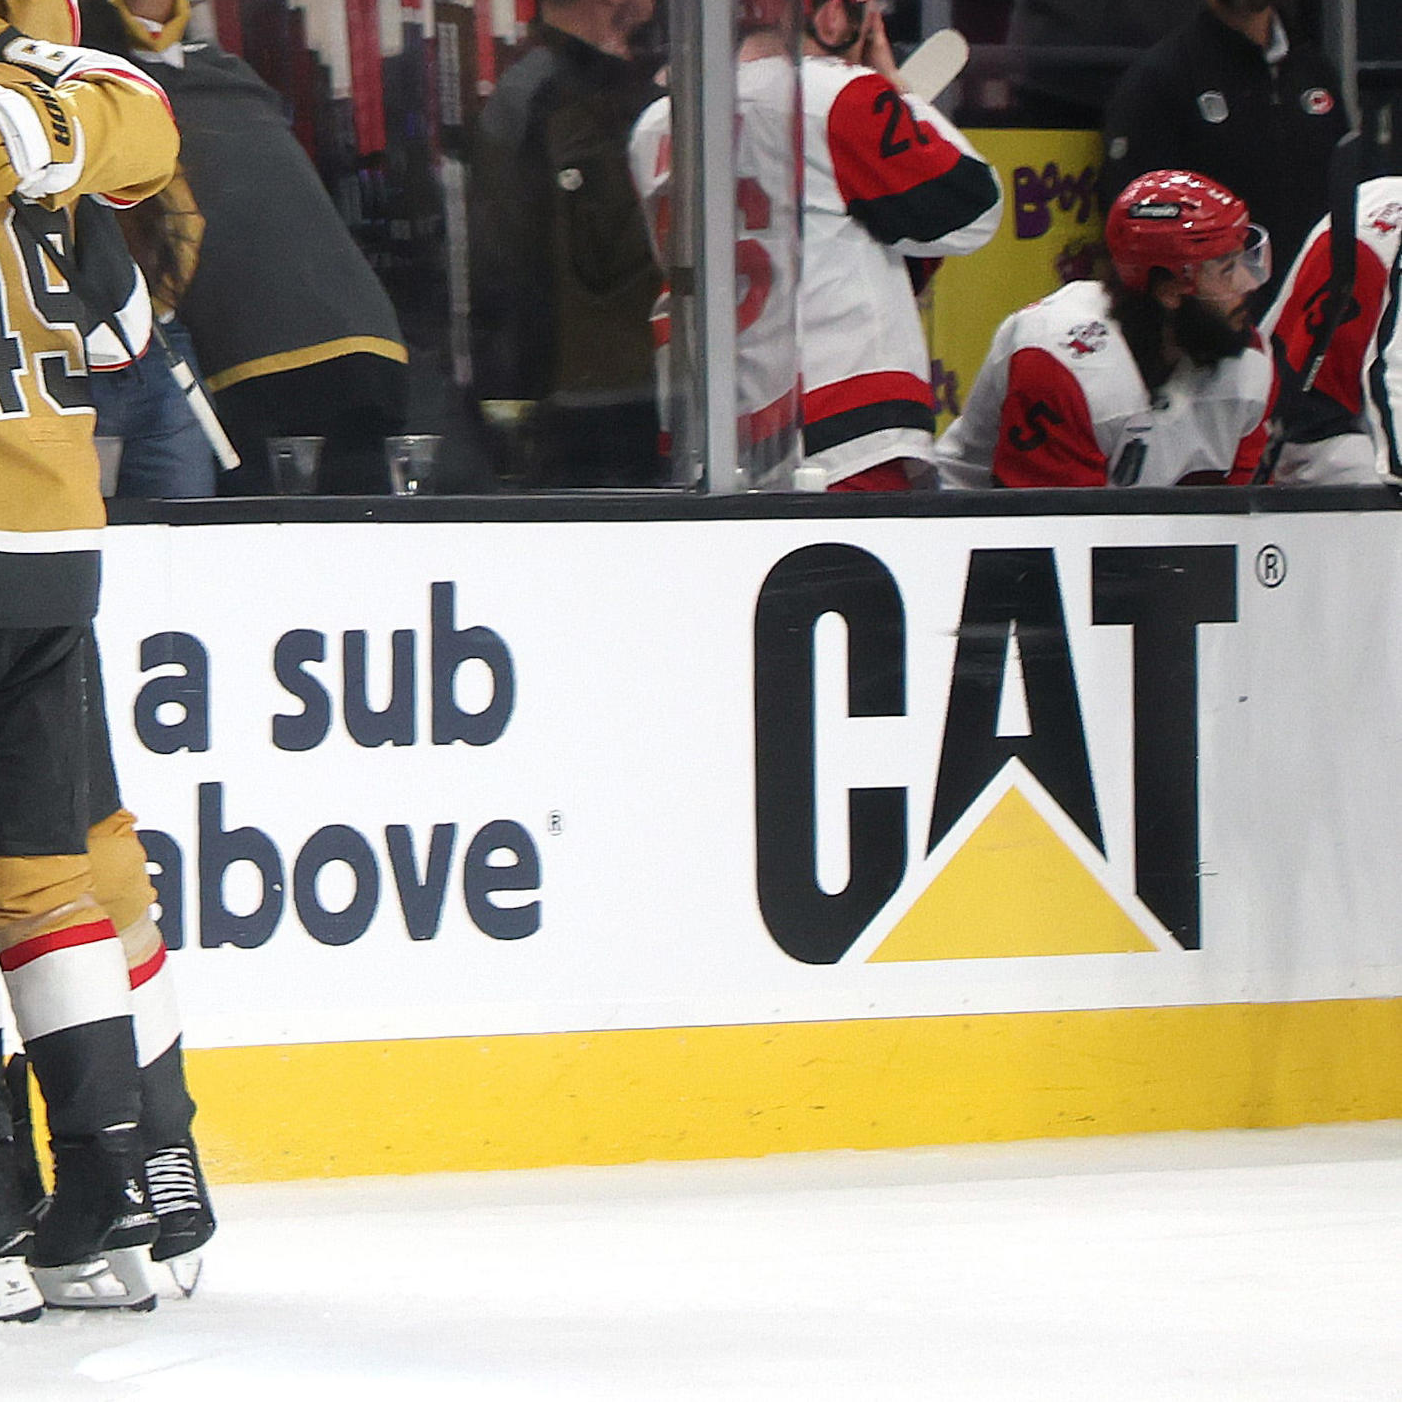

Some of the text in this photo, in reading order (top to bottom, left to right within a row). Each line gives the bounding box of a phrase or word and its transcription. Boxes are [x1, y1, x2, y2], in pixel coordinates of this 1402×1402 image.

[134, 581, 516, 755] a sub
[754, 542, 1239, 965] CAT
